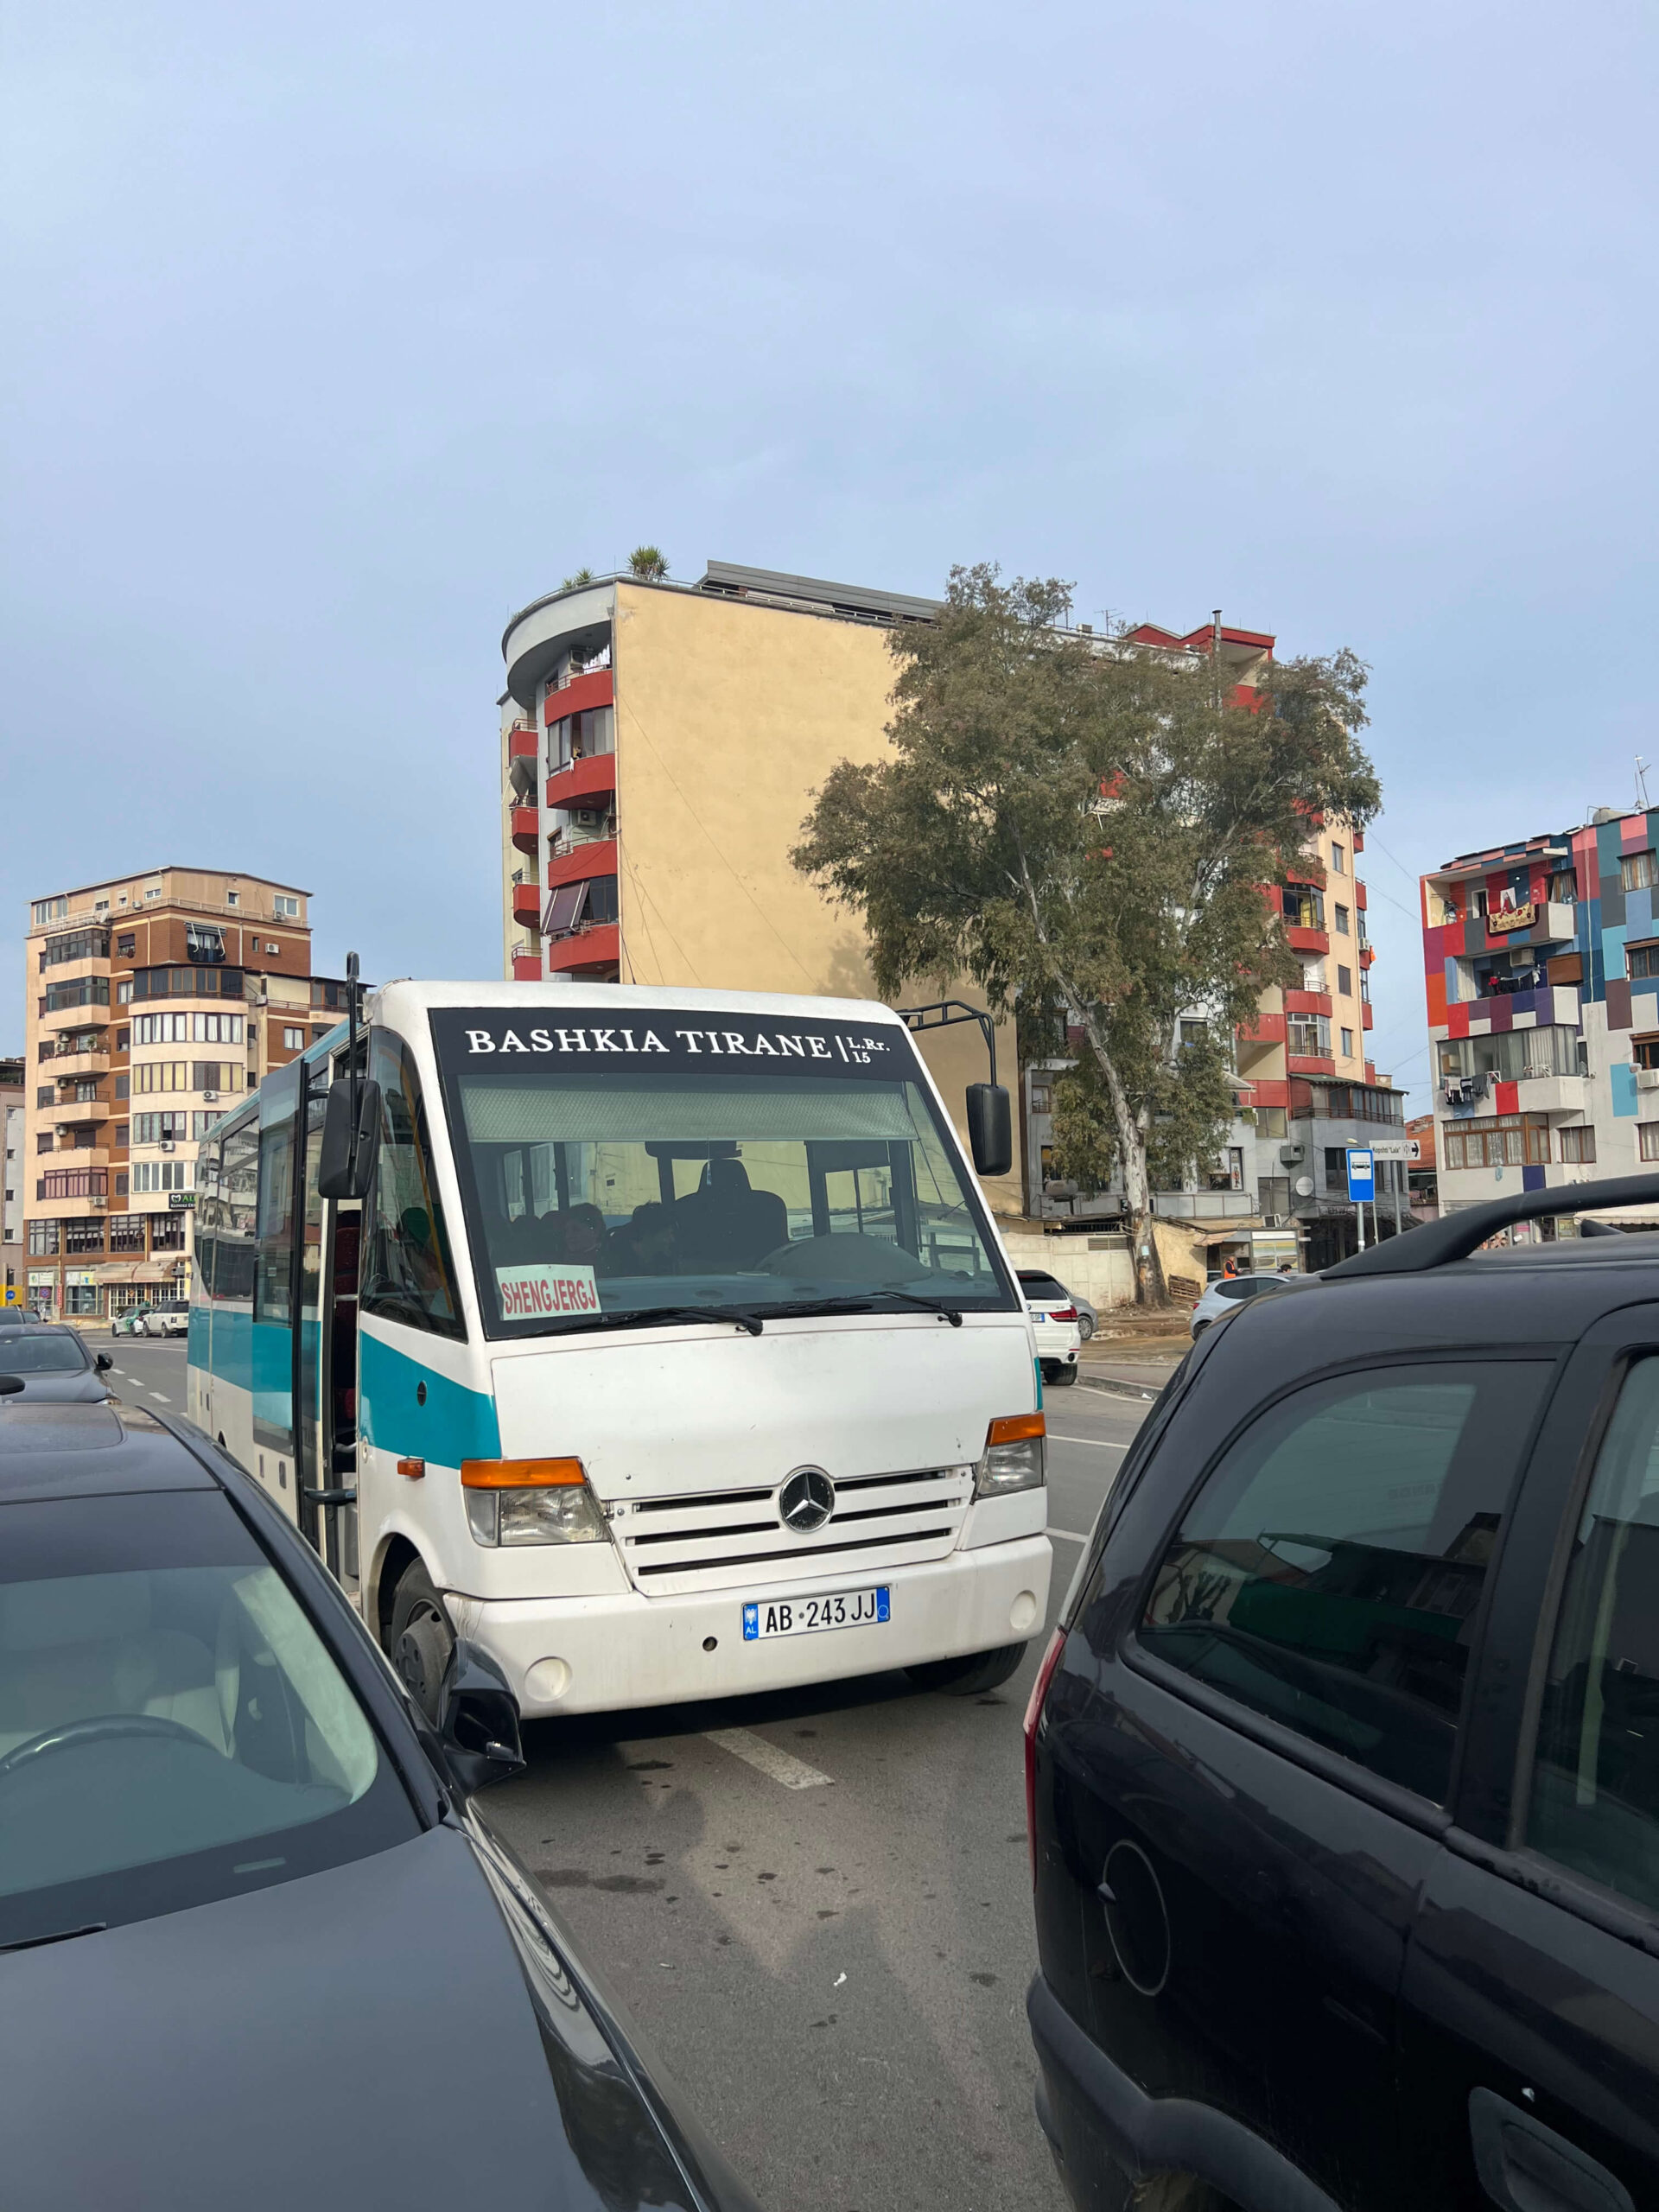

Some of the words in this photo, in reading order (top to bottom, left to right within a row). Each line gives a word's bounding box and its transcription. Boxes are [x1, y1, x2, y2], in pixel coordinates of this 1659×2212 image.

[464, 1029, 671, 1053] BASHKIA
[676, 1031, 832, 1058] TIRANE
[846, 1037, 891, 1052] L.Rr.
[853, 1052, 872, 1064] 15
[501, 1280, 596, 1314] SHENGJERGJ
[766, 1605, 793, 1633] AB
[806, 1597, 846, 1628] 243
[850, 1592, 875, 1621] JJ
[745, 1625, 757, 1635] AL
